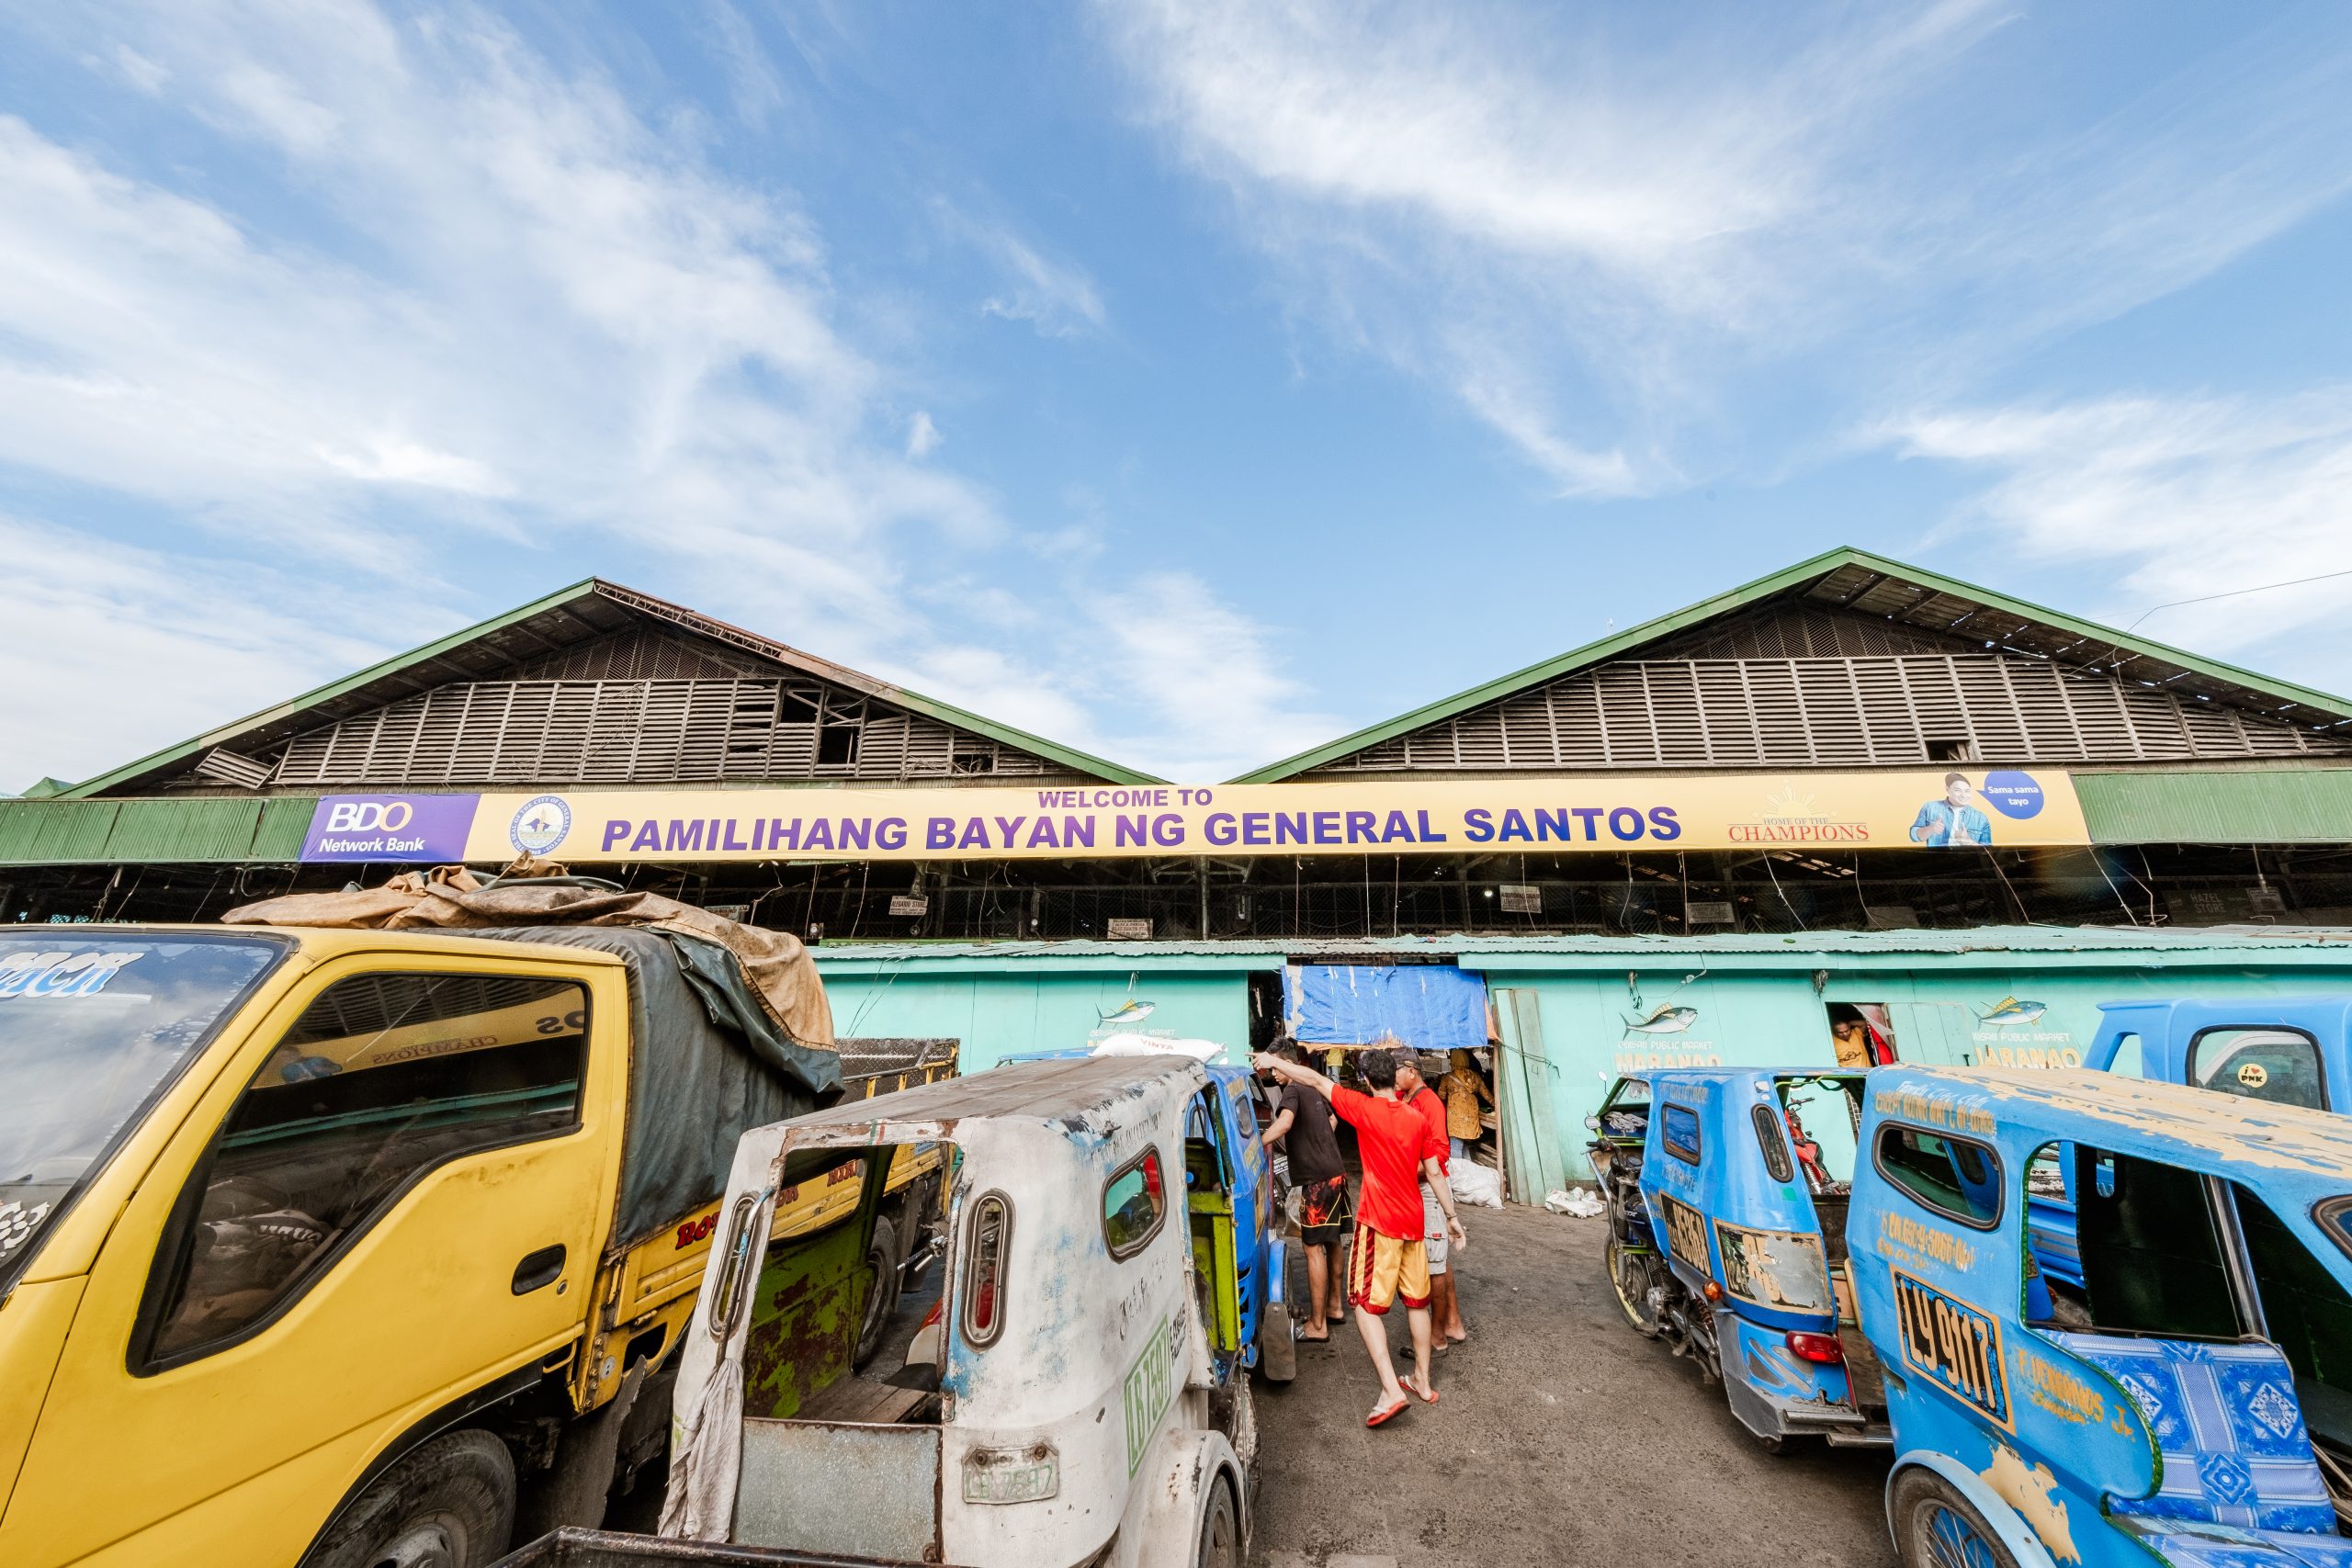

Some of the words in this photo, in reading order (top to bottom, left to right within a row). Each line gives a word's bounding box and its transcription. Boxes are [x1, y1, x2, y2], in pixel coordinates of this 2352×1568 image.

[1038, 790, 1169, 808] WELCOME
[1178, 789, 1213, 807] TO
[2007, 797, 2030, 807] tayo
[326, 802, 413, 832] BDO
[1809, 817, 1829, 825] THE
[601, 817, 908, 852] PAMILIHANG
[925, 815, 1096, 850] BAYAN
[1115, 814, 1186, 847] NG
[1204, 809, 1447, 846] GENERAL
[1464, 806, 1681, 842] SANTOS
[1728, 825, 1869, 841] CHAMPIONS
[319, 837, 383, 852] Network
[387, 836, 425, 852] Bank
[2190, 893, 2221, 902] HAZEL
[2194, 903, 2227, 913] STORE
[2001, 1032, 2030, 1042] PUBLIC
[2033, 1033, 2070, 1042] MARKET
[1140, 1038, 1174, 1050] VINTA
[1682, 1042, 1713, 1050] MARKET
[1935, 1298, 1996, 1409] 9117
